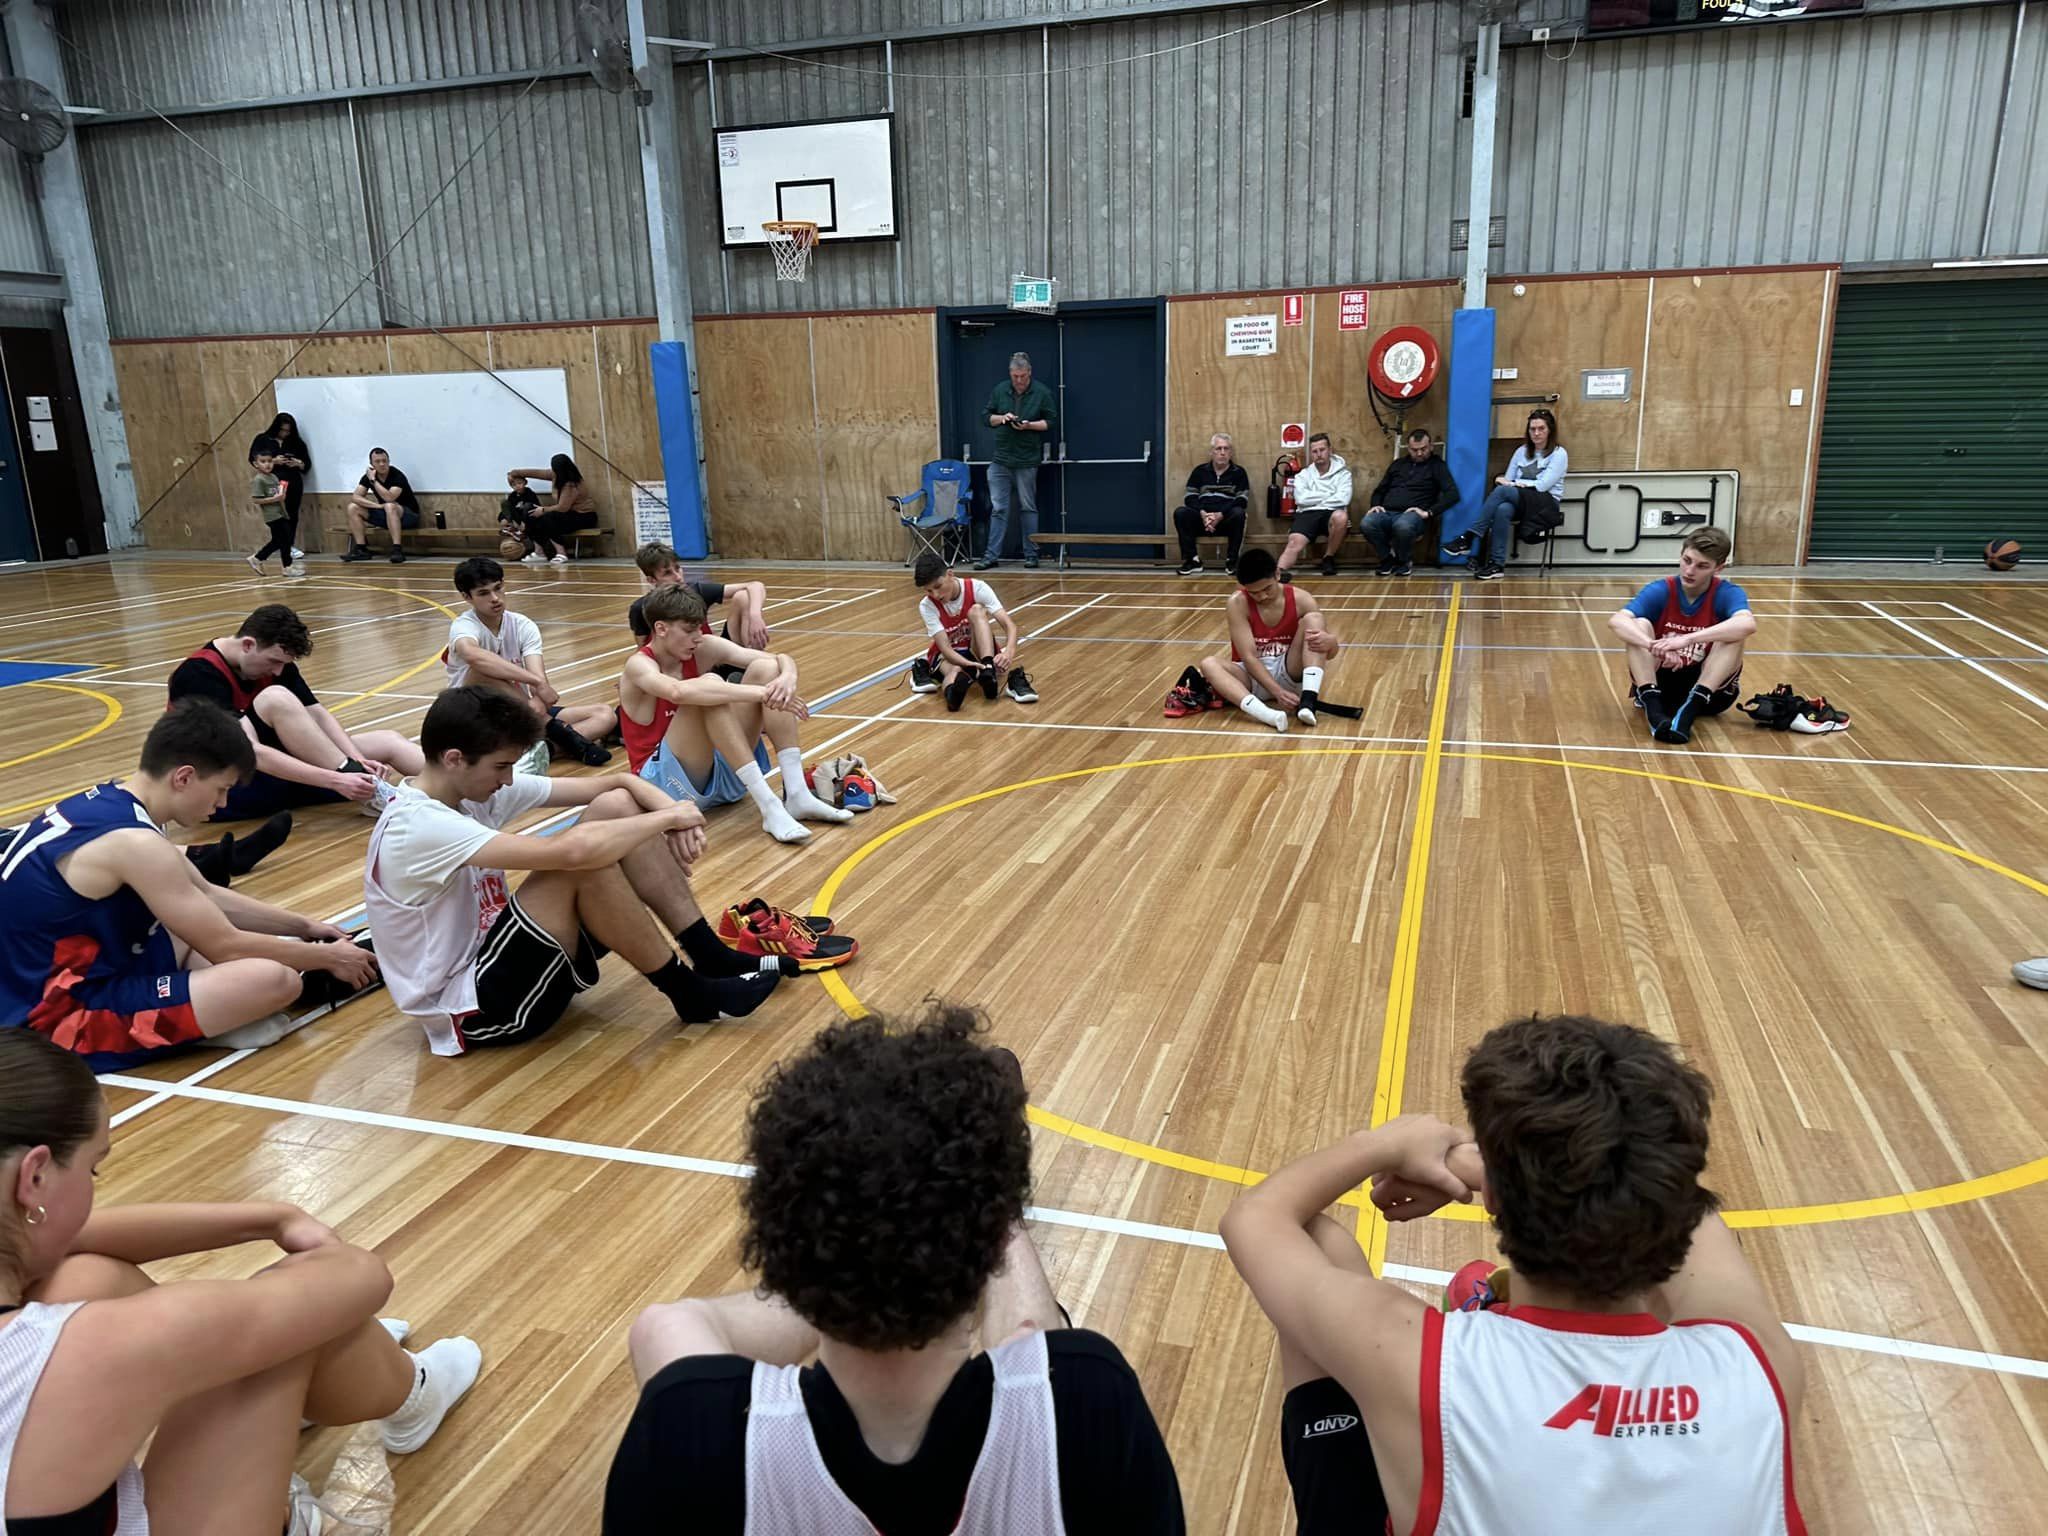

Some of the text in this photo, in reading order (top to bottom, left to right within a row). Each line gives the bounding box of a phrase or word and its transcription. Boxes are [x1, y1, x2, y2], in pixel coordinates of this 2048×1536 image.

[1344, 293, 1364, 304] FIRE
[1342, 304, 1366, 314] HOSE
[1342, 314, 1365, 325] REEL
[1541, 1383, 1700, 1437] ALLIED
[1614, 1422, 1700, 1438] EXPRESS
